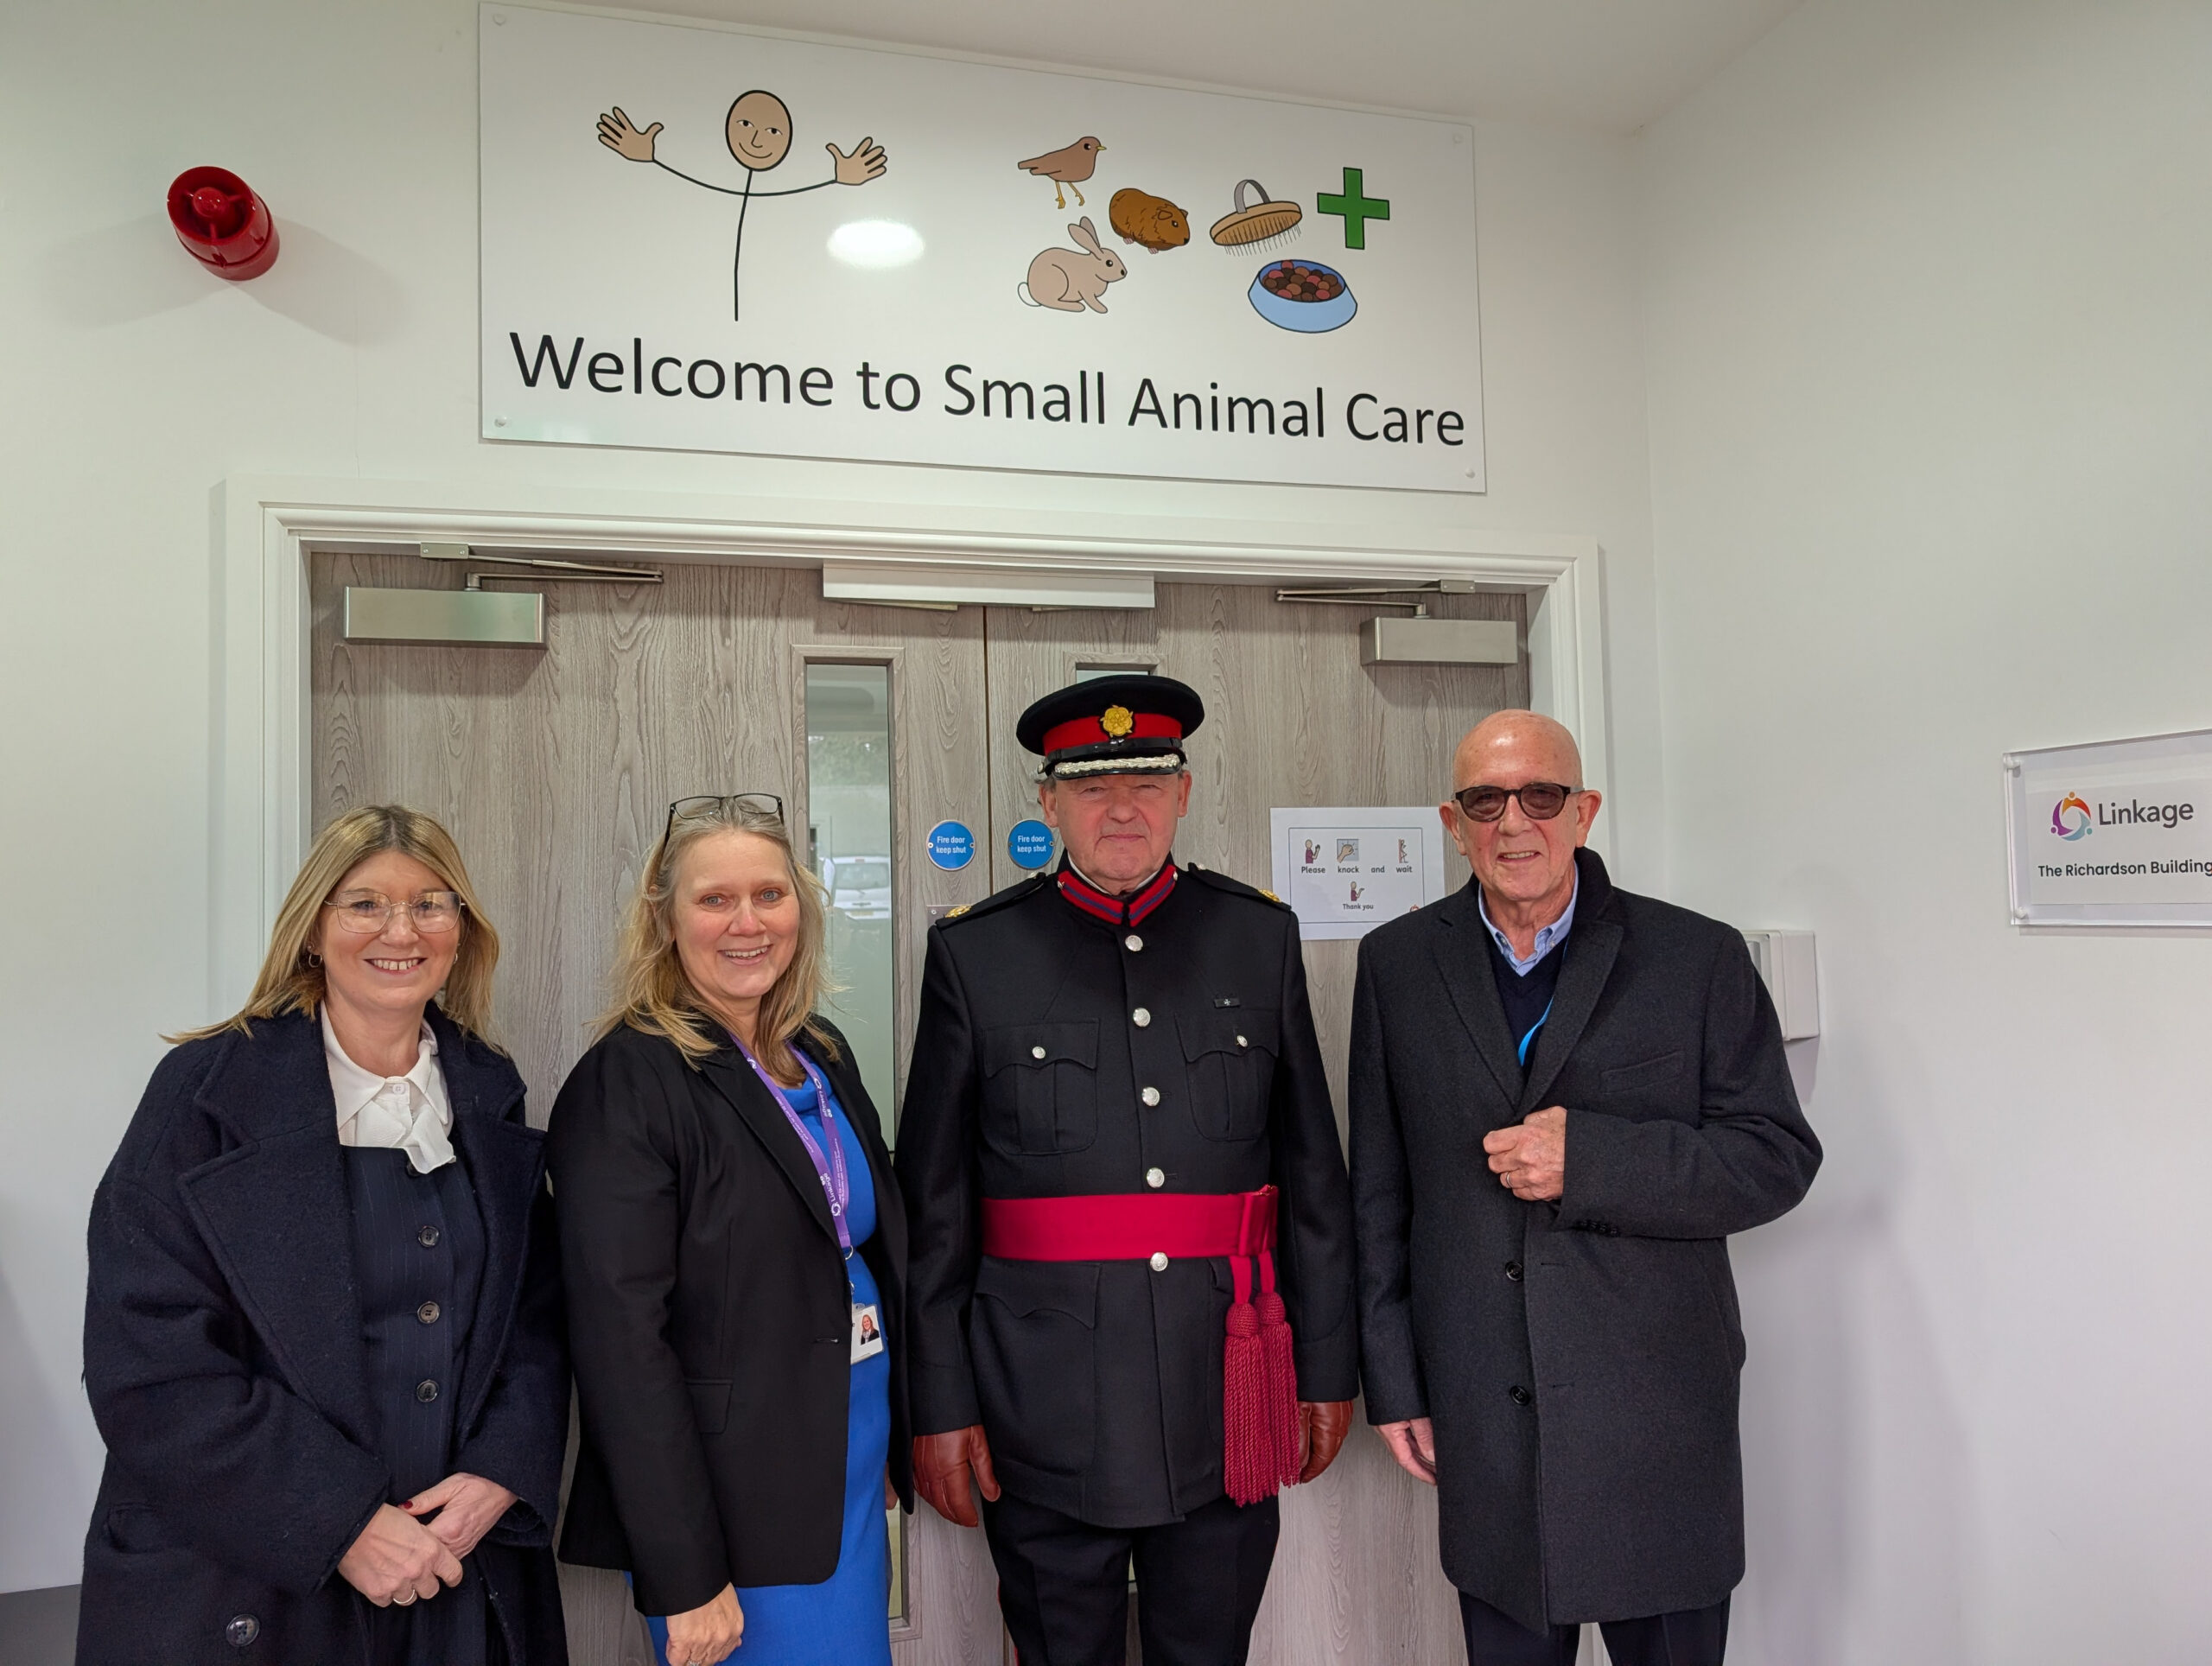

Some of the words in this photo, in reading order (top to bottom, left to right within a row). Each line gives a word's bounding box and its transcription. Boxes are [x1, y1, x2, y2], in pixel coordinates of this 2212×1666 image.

[509, 332, 834, 407] Welcome
[855, 361, 921, 412] to
[944, 364, 1105, 424] Small
[1128, 378, 1325, 438] Animal
[1346, 392, 1465, 447] Care
[2098, 798, 2195, 830] Linkage
[936, 846, 951, 855] keep
[1395, 865, 1413, 874] wait
[2037, 864, 2063, 877] The
[2065, 862, 2147, 877] Richardson
[2150, 858, 2212, 877] Building
[823, 1173, 836, 1202] Linkage
